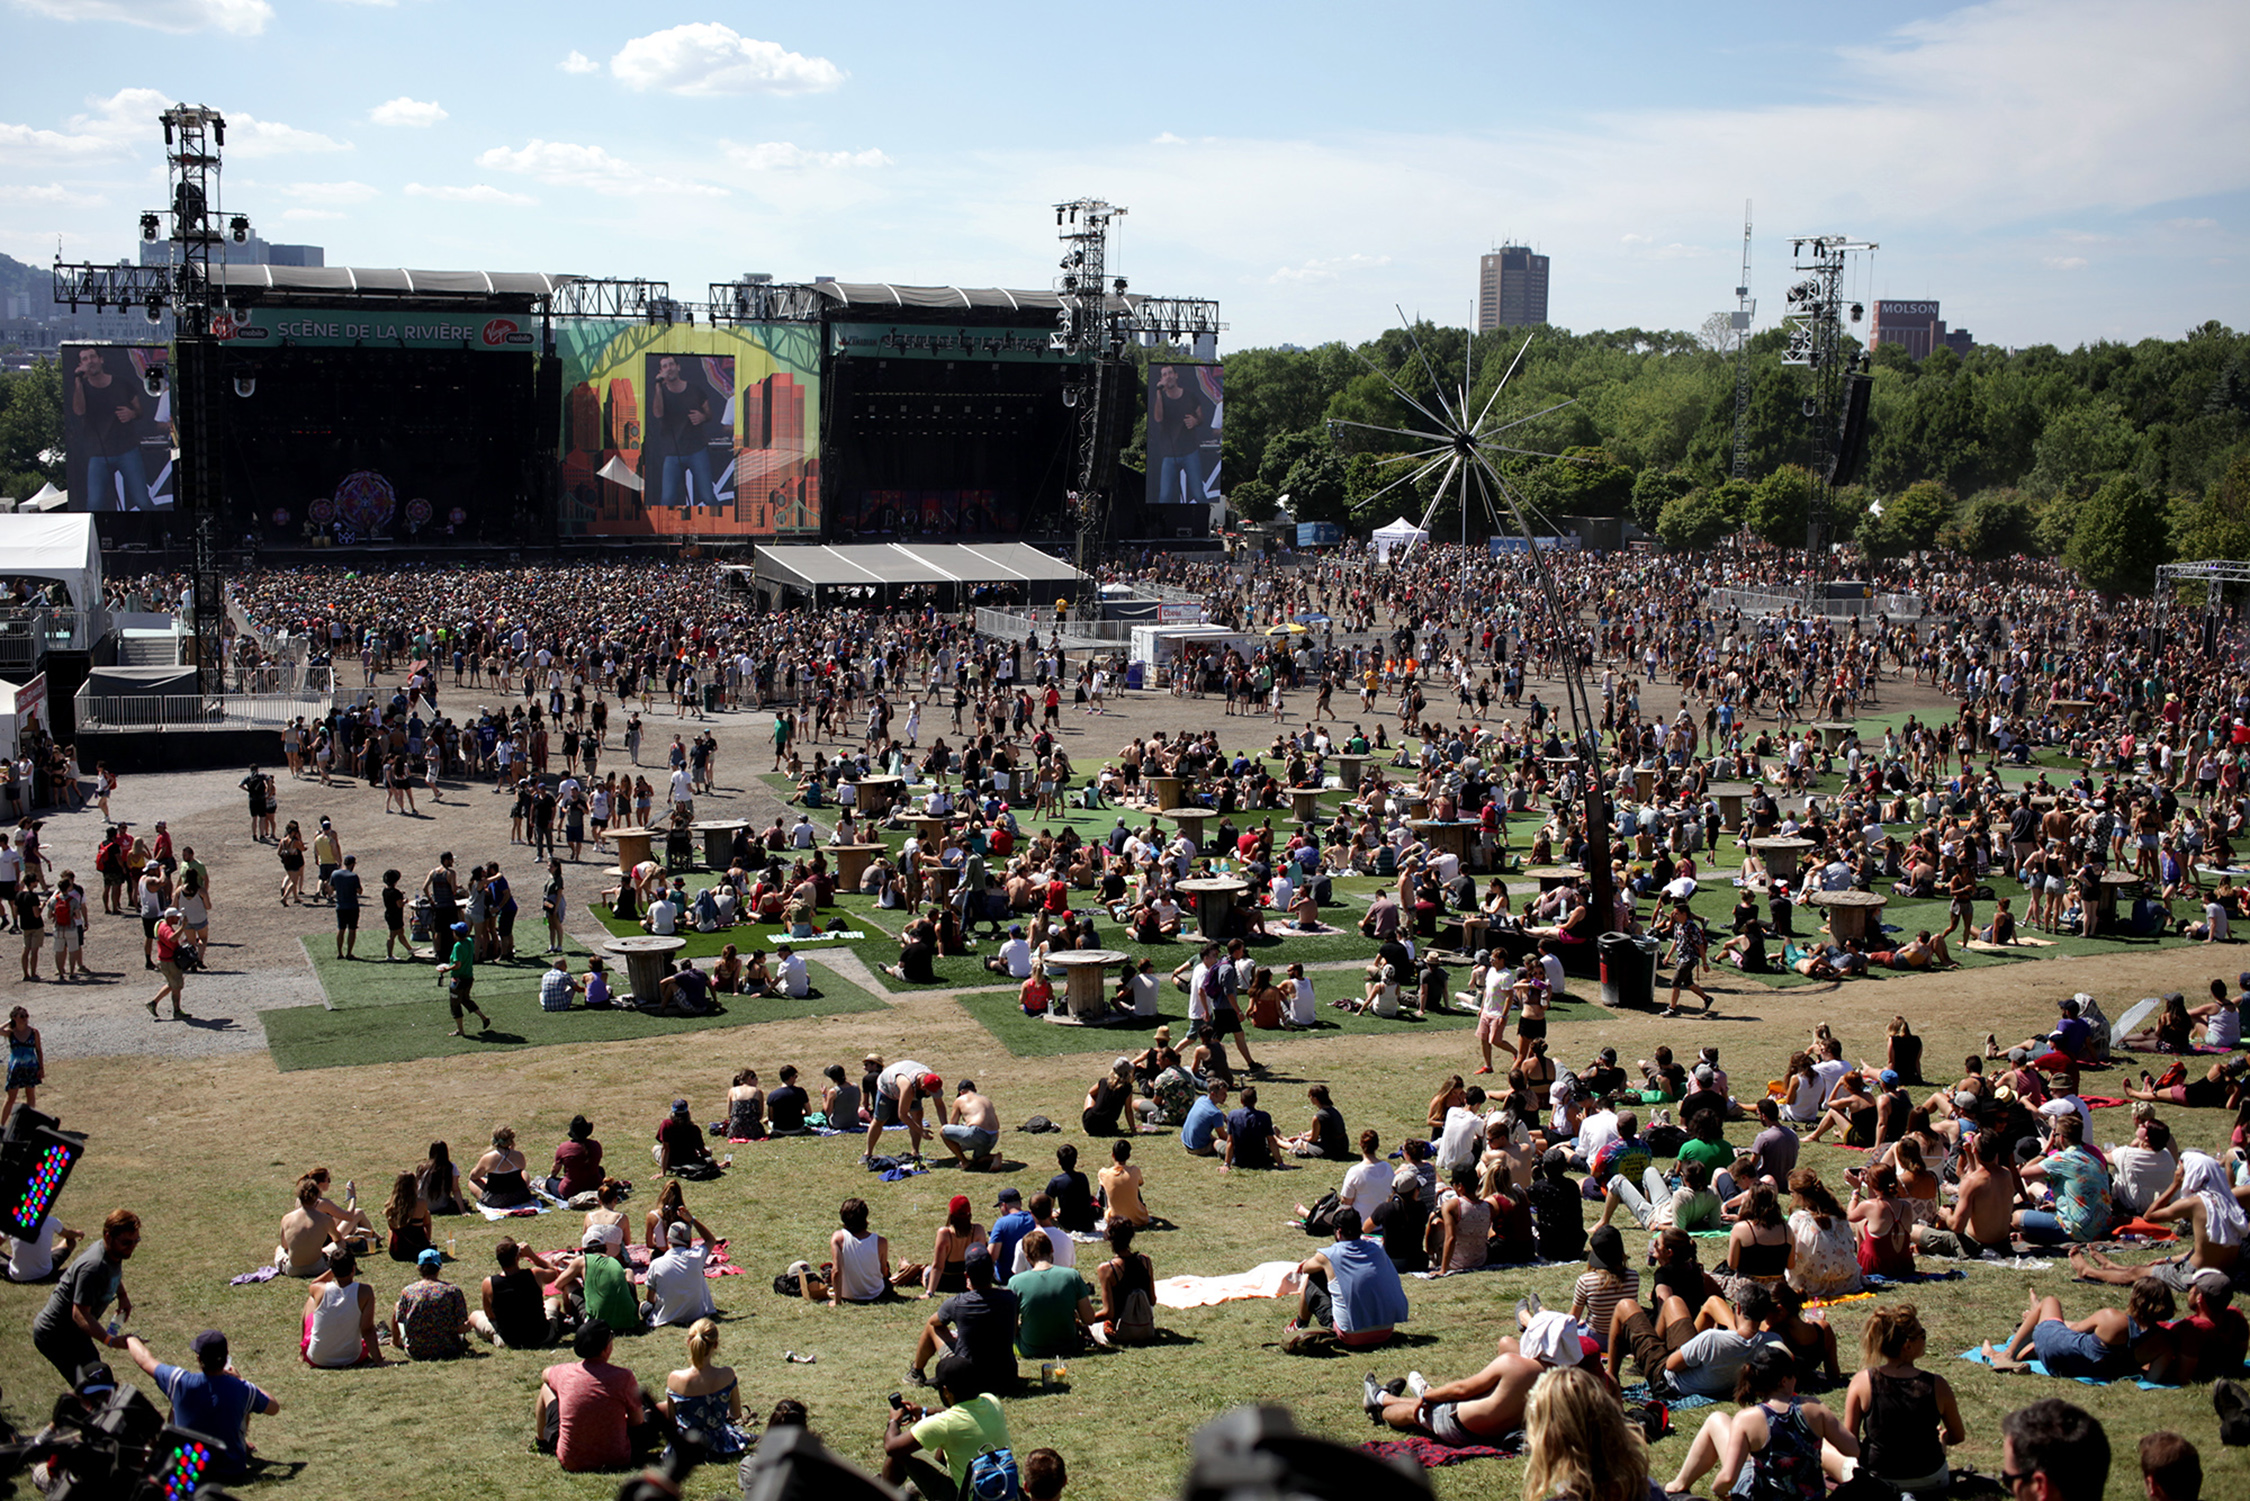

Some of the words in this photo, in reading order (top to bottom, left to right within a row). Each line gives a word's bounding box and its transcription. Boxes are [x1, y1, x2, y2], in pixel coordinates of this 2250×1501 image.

[1881, 303, 1937, 314] MOLSON
[240, 329, 265, 337] mobile
[277, 319, 339, 337] SCÈNE
[346, 324, 370, 338] DE
[376, 325, 398, 338] LA
[404, 322, 473, 340] RIVIÈRE
[486, 319, 512, 343] Virgin
[508, 334, 531, 342] mobile
